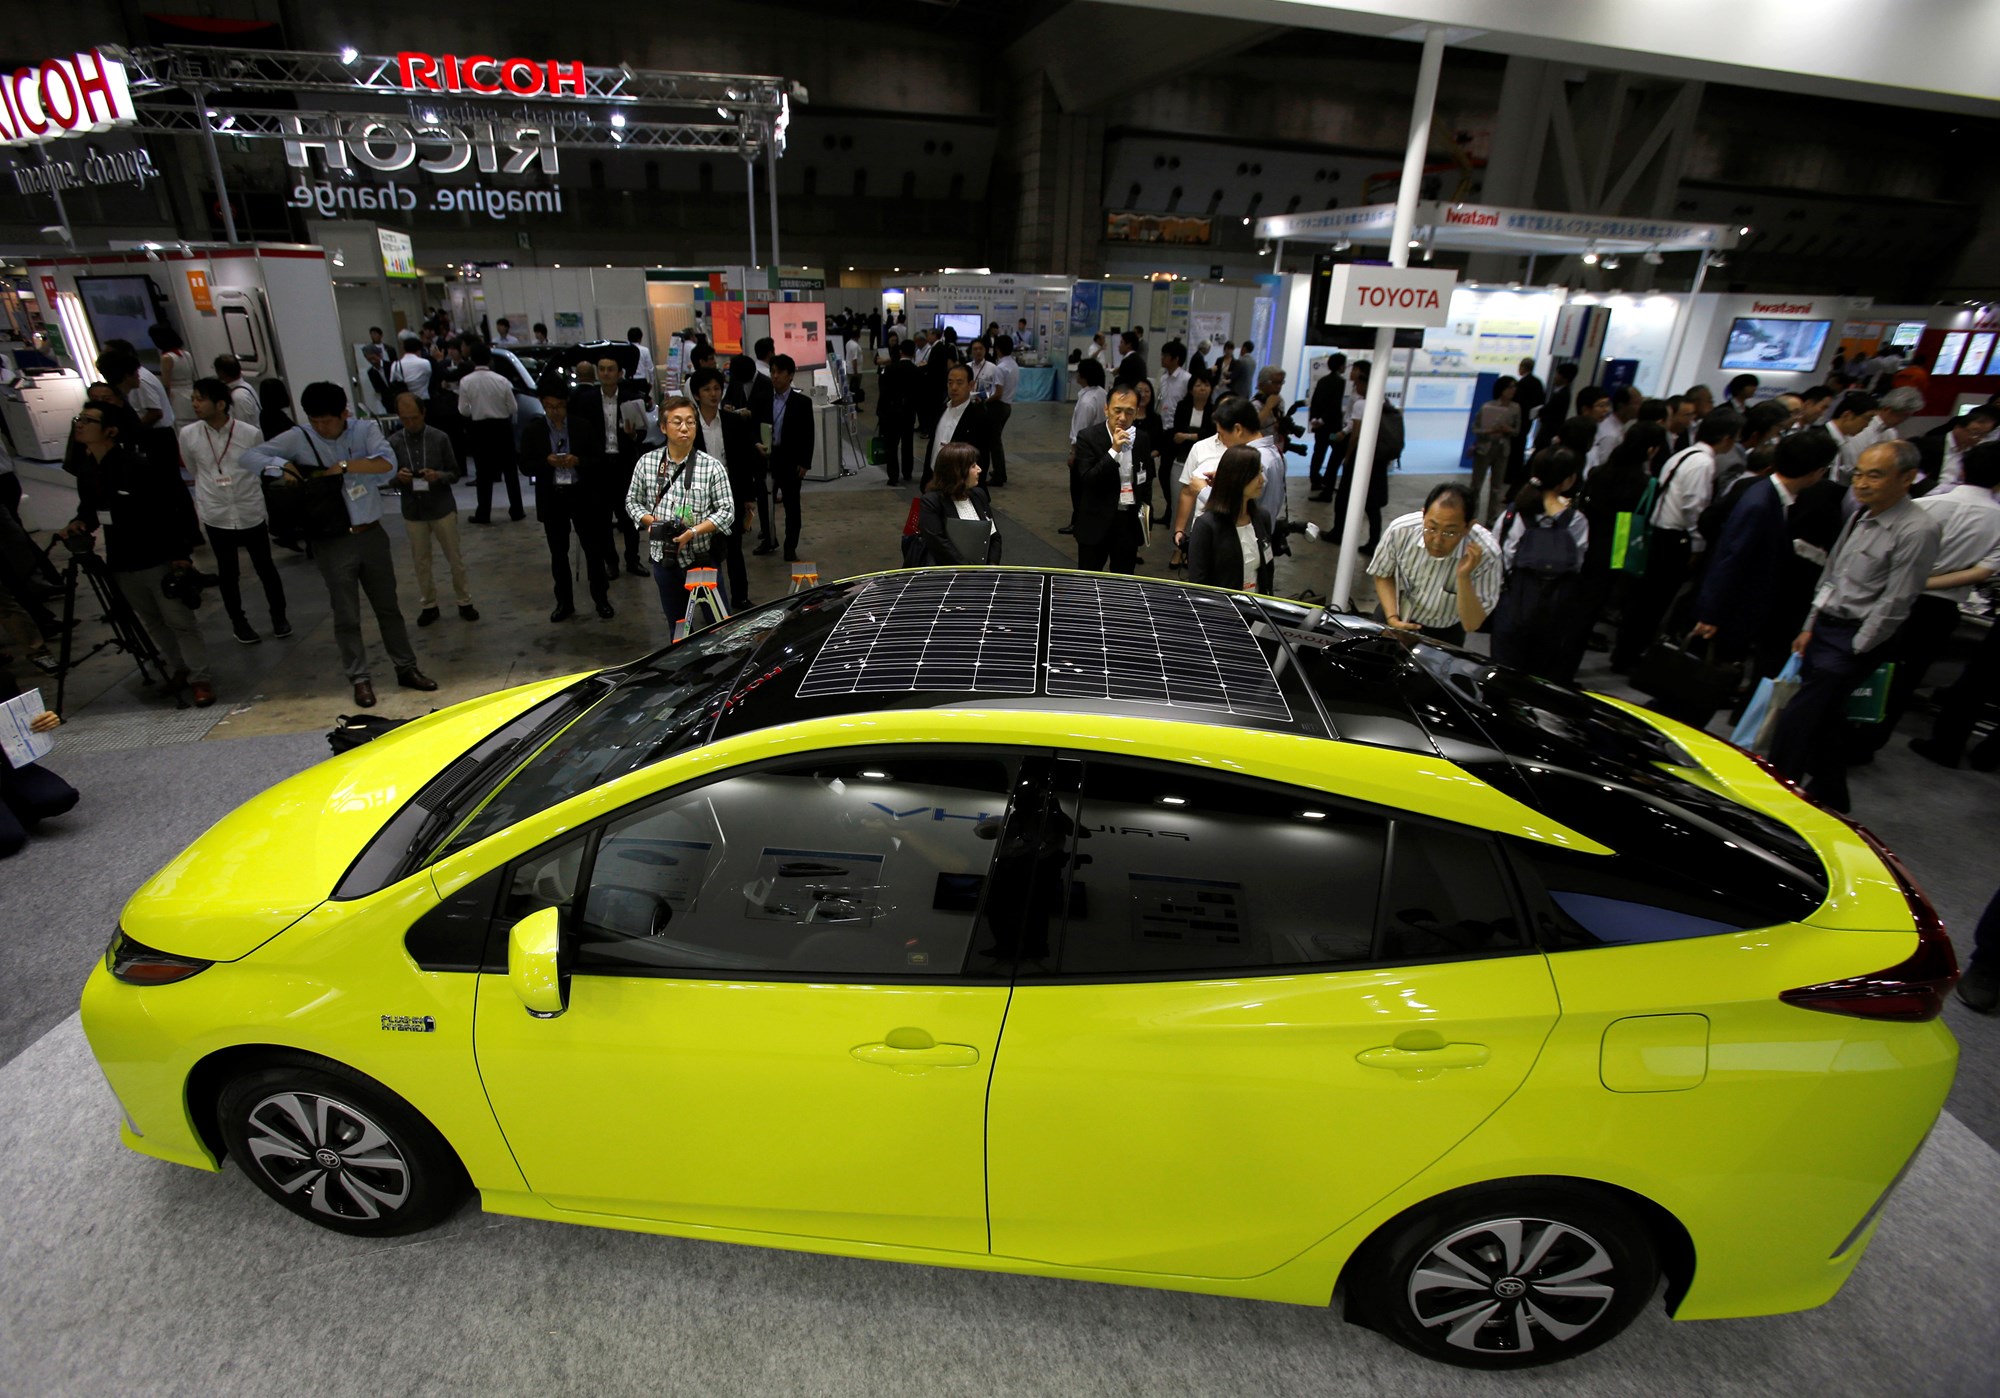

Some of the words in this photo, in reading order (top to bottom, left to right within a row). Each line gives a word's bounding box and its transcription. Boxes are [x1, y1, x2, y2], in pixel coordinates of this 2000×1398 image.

[397, 51, 588, 98] RICOH
[0, 47, 120, 140] ICOH
[10, 160, 85, 198] imagine.
[84, 147, 160, 191] change.
[1446, 207, 1501, 228] Iwatani
[1358, 286, 1440, 309] TOYOTA
[1752, 301, 1813, 314] Iwatani
[382, 1024, 423, 1032] HYBRID
